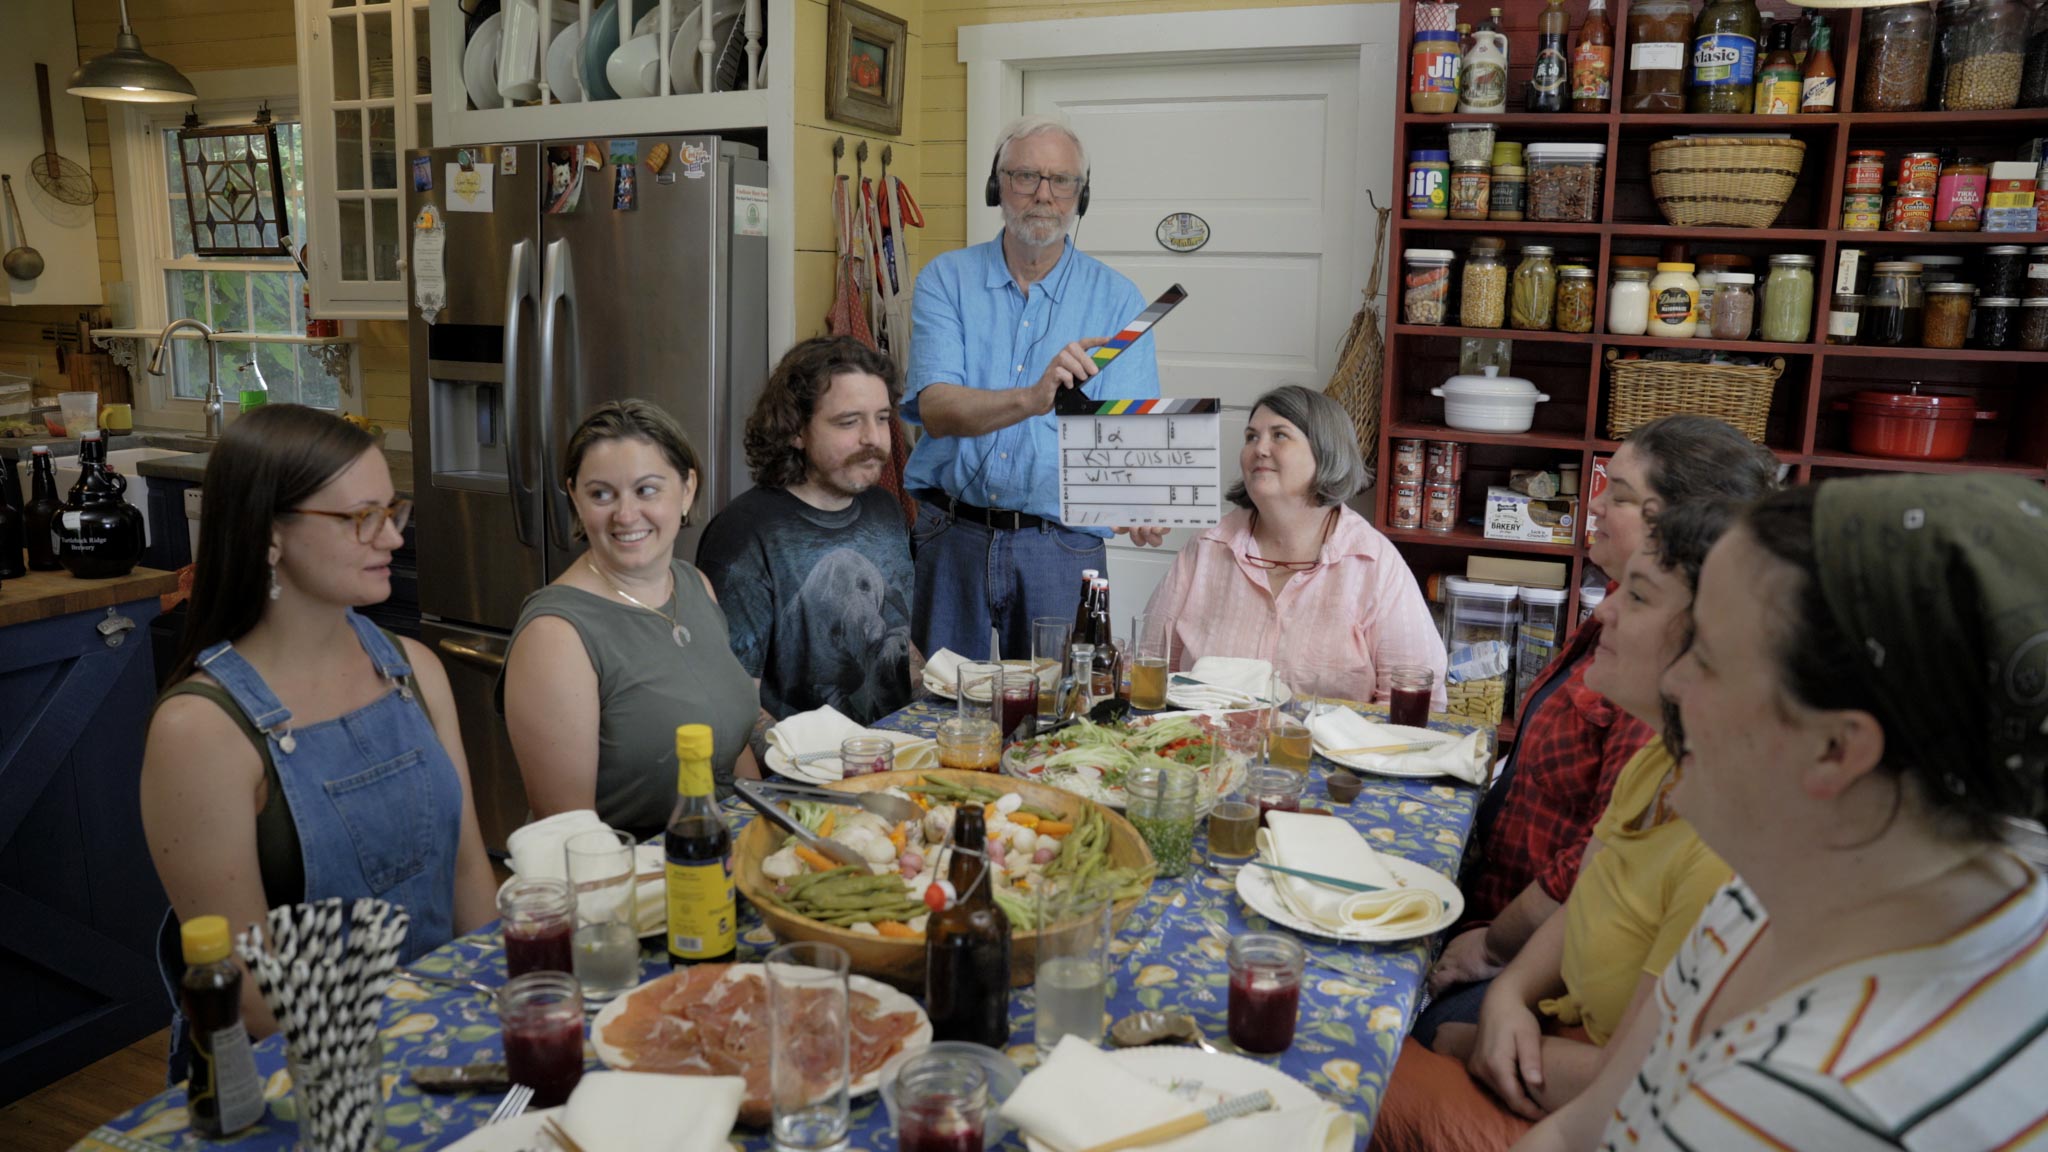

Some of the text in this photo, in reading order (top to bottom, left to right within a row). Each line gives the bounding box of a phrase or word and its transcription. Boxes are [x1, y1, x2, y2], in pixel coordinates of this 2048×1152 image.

[1407, 170, 1443, 196] Jif
[1082, 449, 1196, 467] KY CUISINE
[1491, 521, 1521, 531] BAKERY
